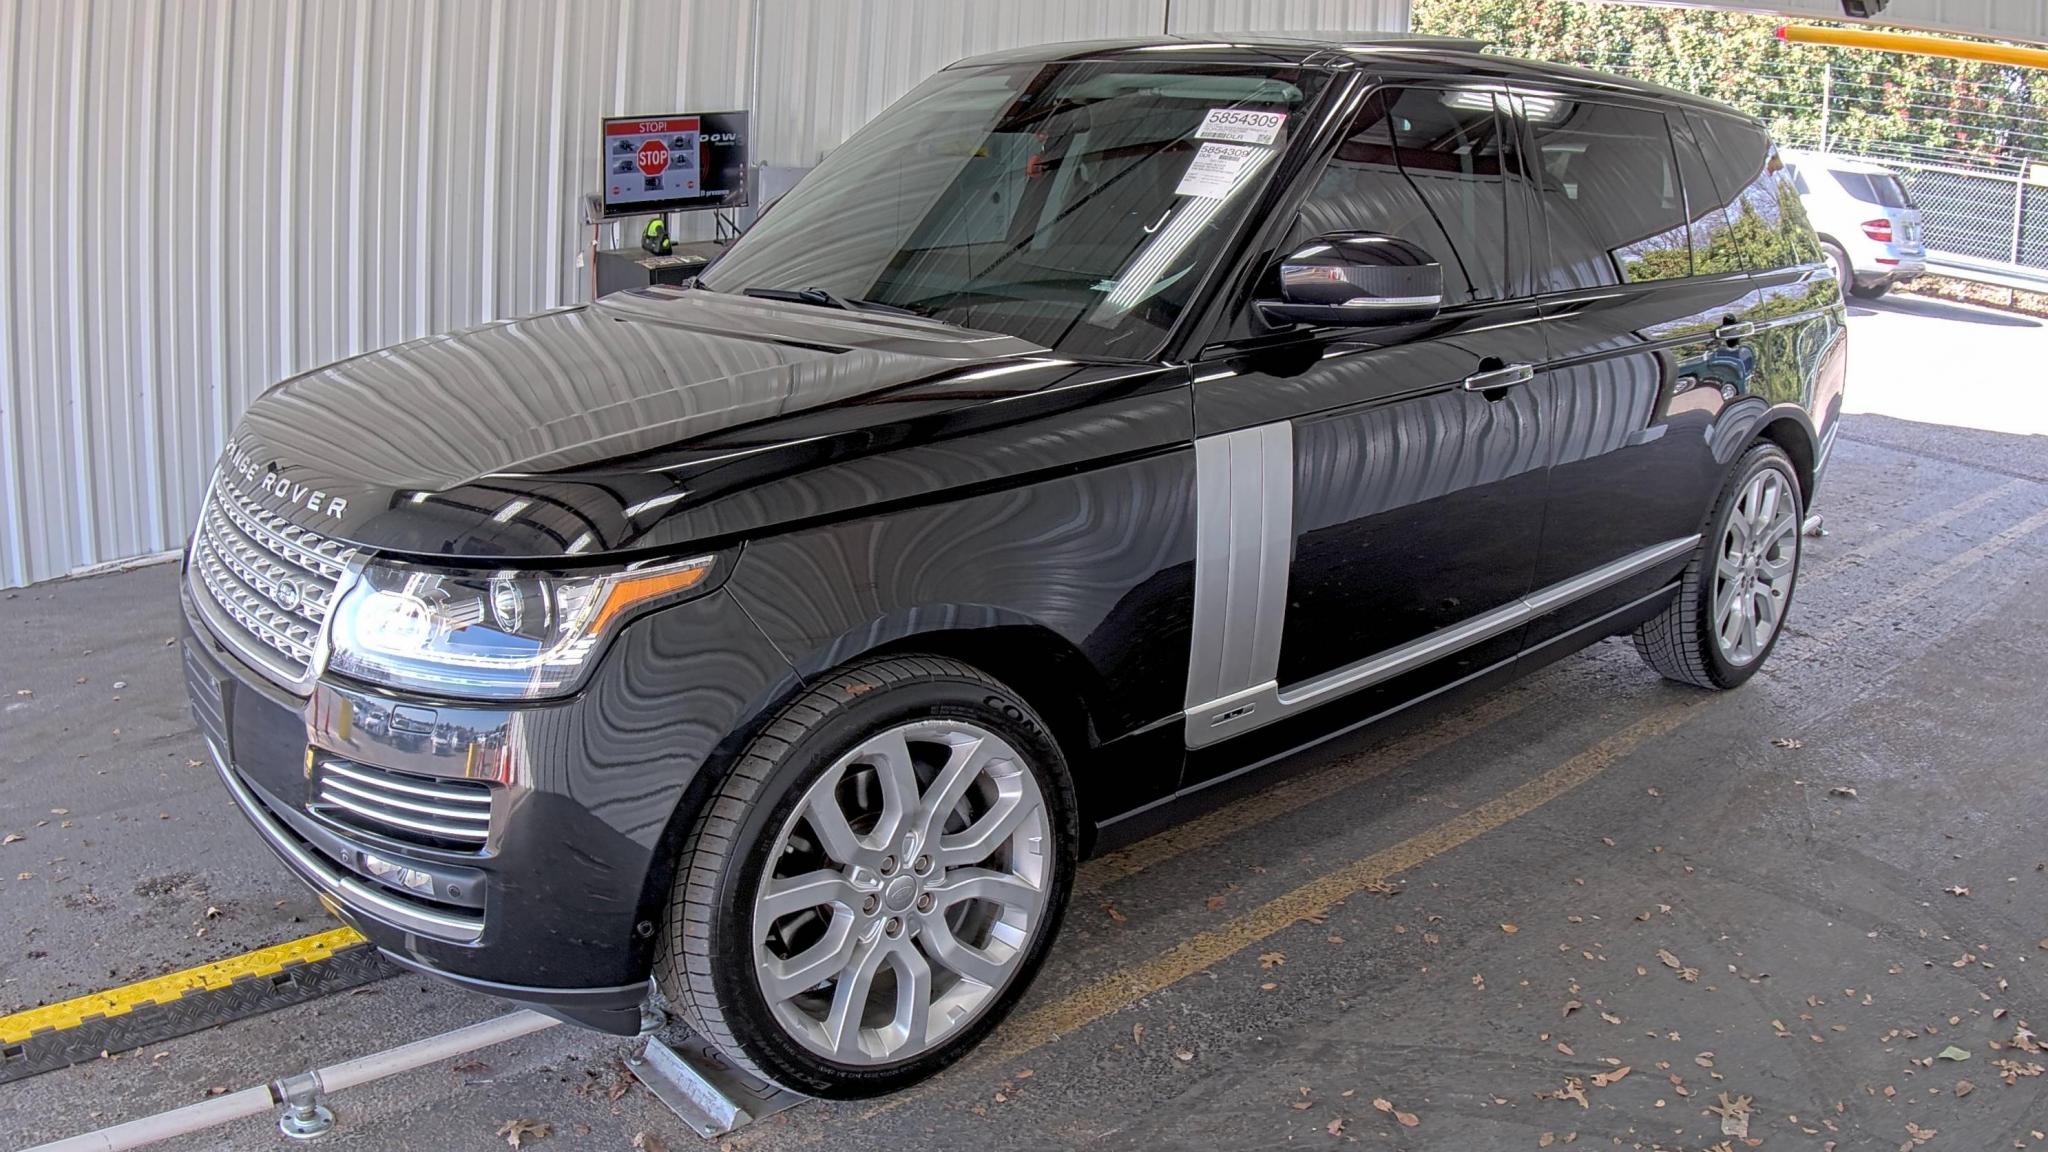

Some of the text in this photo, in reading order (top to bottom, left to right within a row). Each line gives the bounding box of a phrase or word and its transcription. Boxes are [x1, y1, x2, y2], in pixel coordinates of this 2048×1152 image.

[639, 121, 668, 133] STOP!
[1208, 111, 1280, 128] 5854309
[639, 150, 669, 166] STOP
[1200, 145, 1251, 158] 5854309
[261, 471, 349, 519] ROVER
